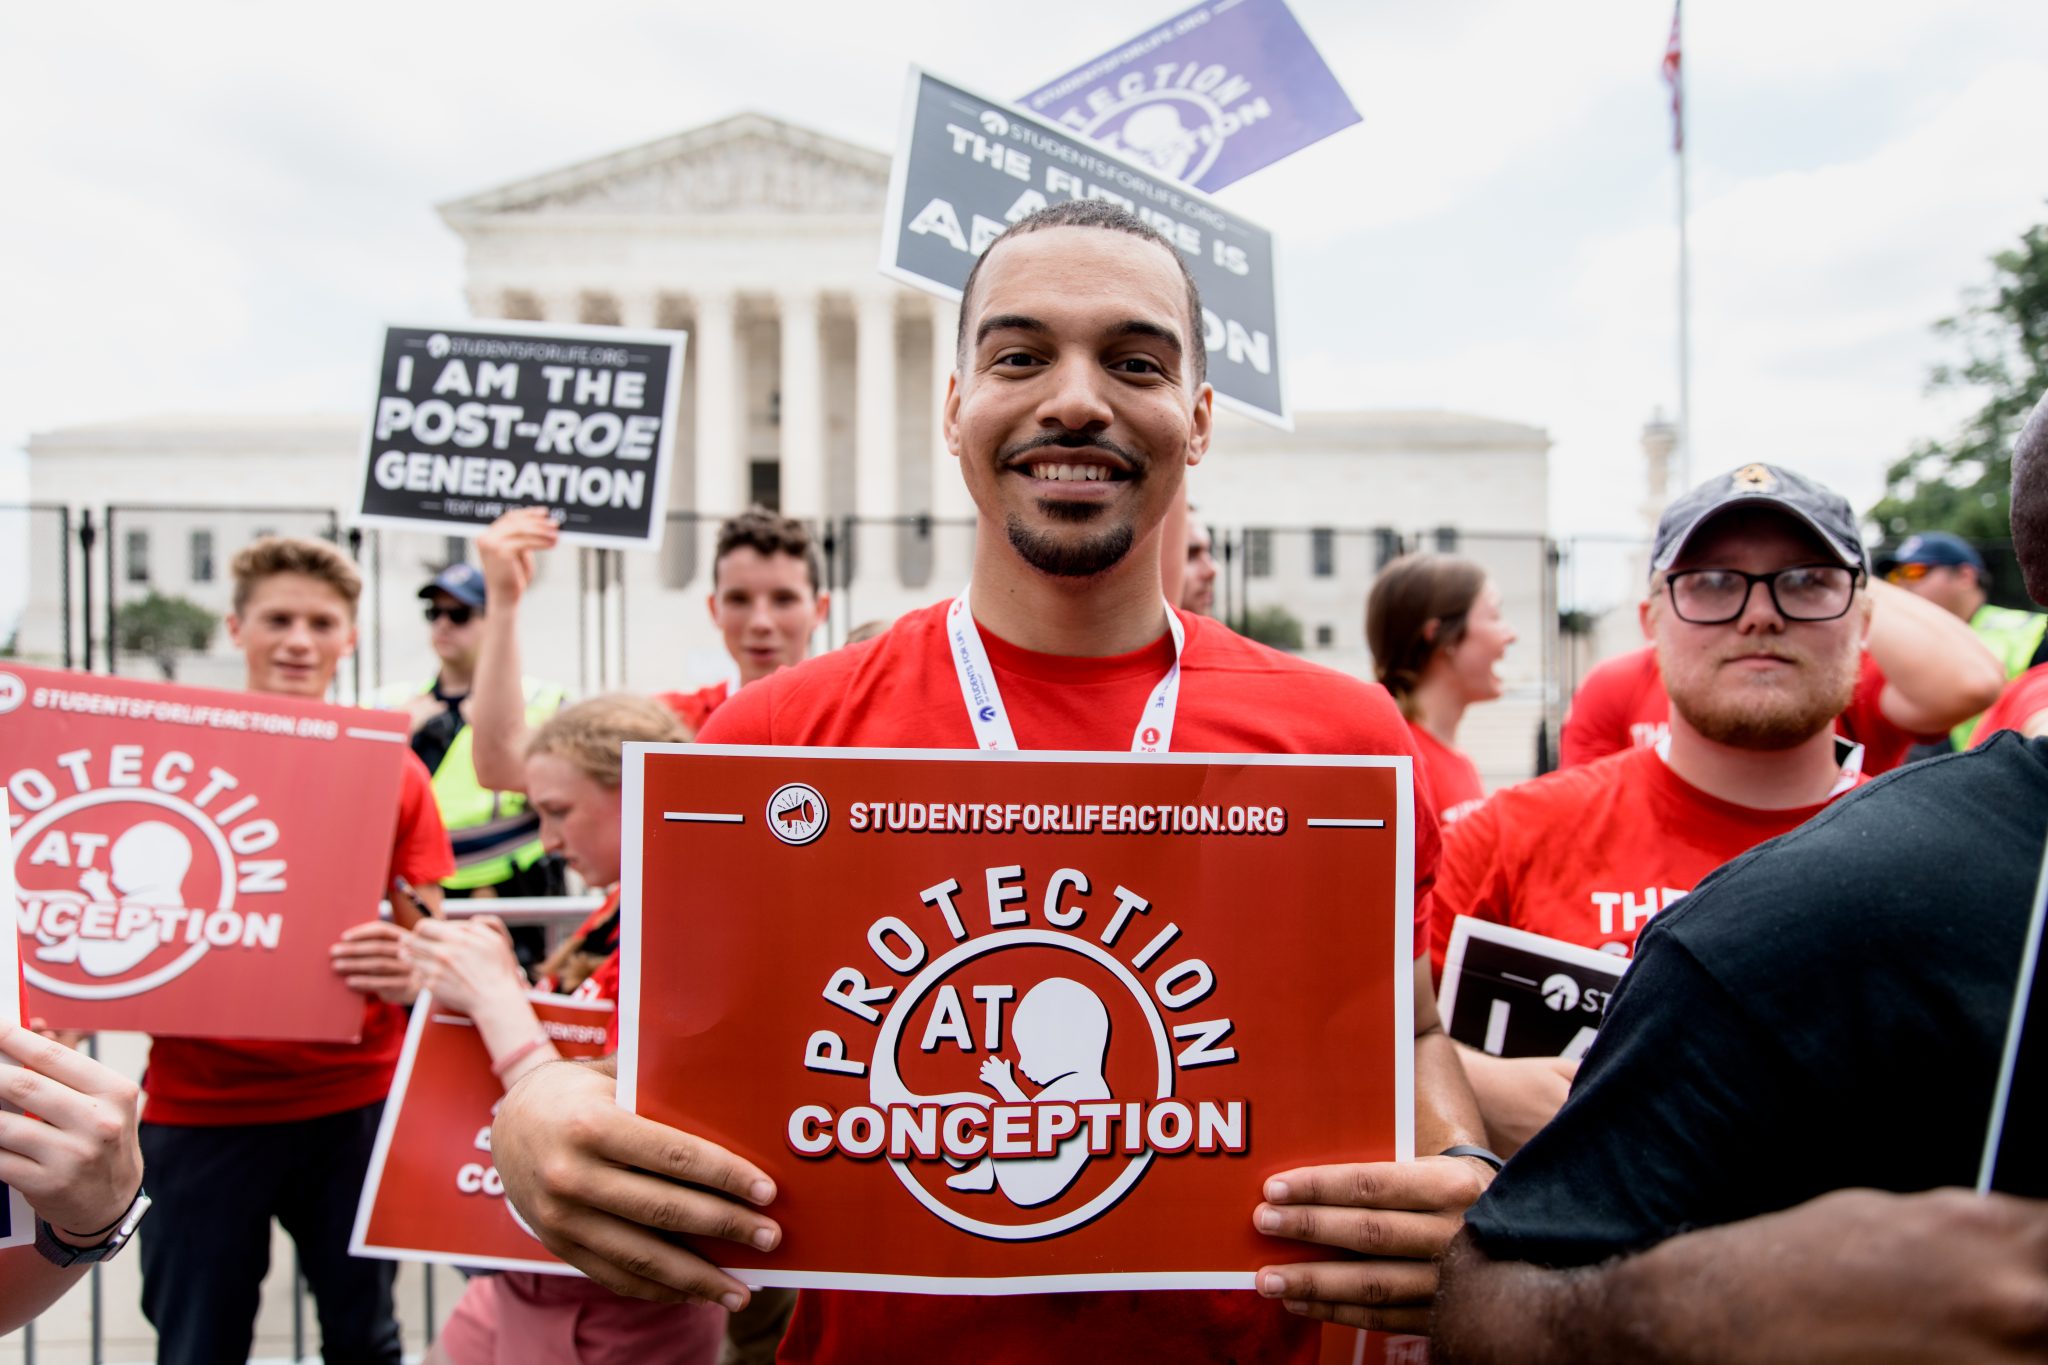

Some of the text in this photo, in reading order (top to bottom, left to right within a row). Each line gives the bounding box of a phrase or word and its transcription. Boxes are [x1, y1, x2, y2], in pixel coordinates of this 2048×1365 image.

[1057, 61, 1253, 134] TECTION
[946, 122, 1032, 182] THE
[1212, 239, 1250, 276] IS
[1010, 123, 1227, 232] STUDENTSFORLIFE.ORG
[449, 337, 629, 366] STUDENTSFORLIFE.ORG
[396, 355, 648, 409] I AM THE
[375, 396, 661, 461] POST-ROE
[374, 450, 646, 510] GENERATION
[959, 646, 971, 664] FOR
[966, 664, 985, 706] STUDENTS
[32, 687, 339, 741] STUDENTSFORLIFEACTION.ORG
[9, 744, 288, 895] OTECTION
[849, 801, 1286, 834] STUDENTSFORLIFEACTION.ORG
[30, 830, 109, 869] AT
[16, 899, 283, 949] NCEPTION
[804, 864, 1237, 1077] PROTECTION
[920, 984, 1015, 1052] AT
[787, 1102, 1244, 1157] CONCEPTION
